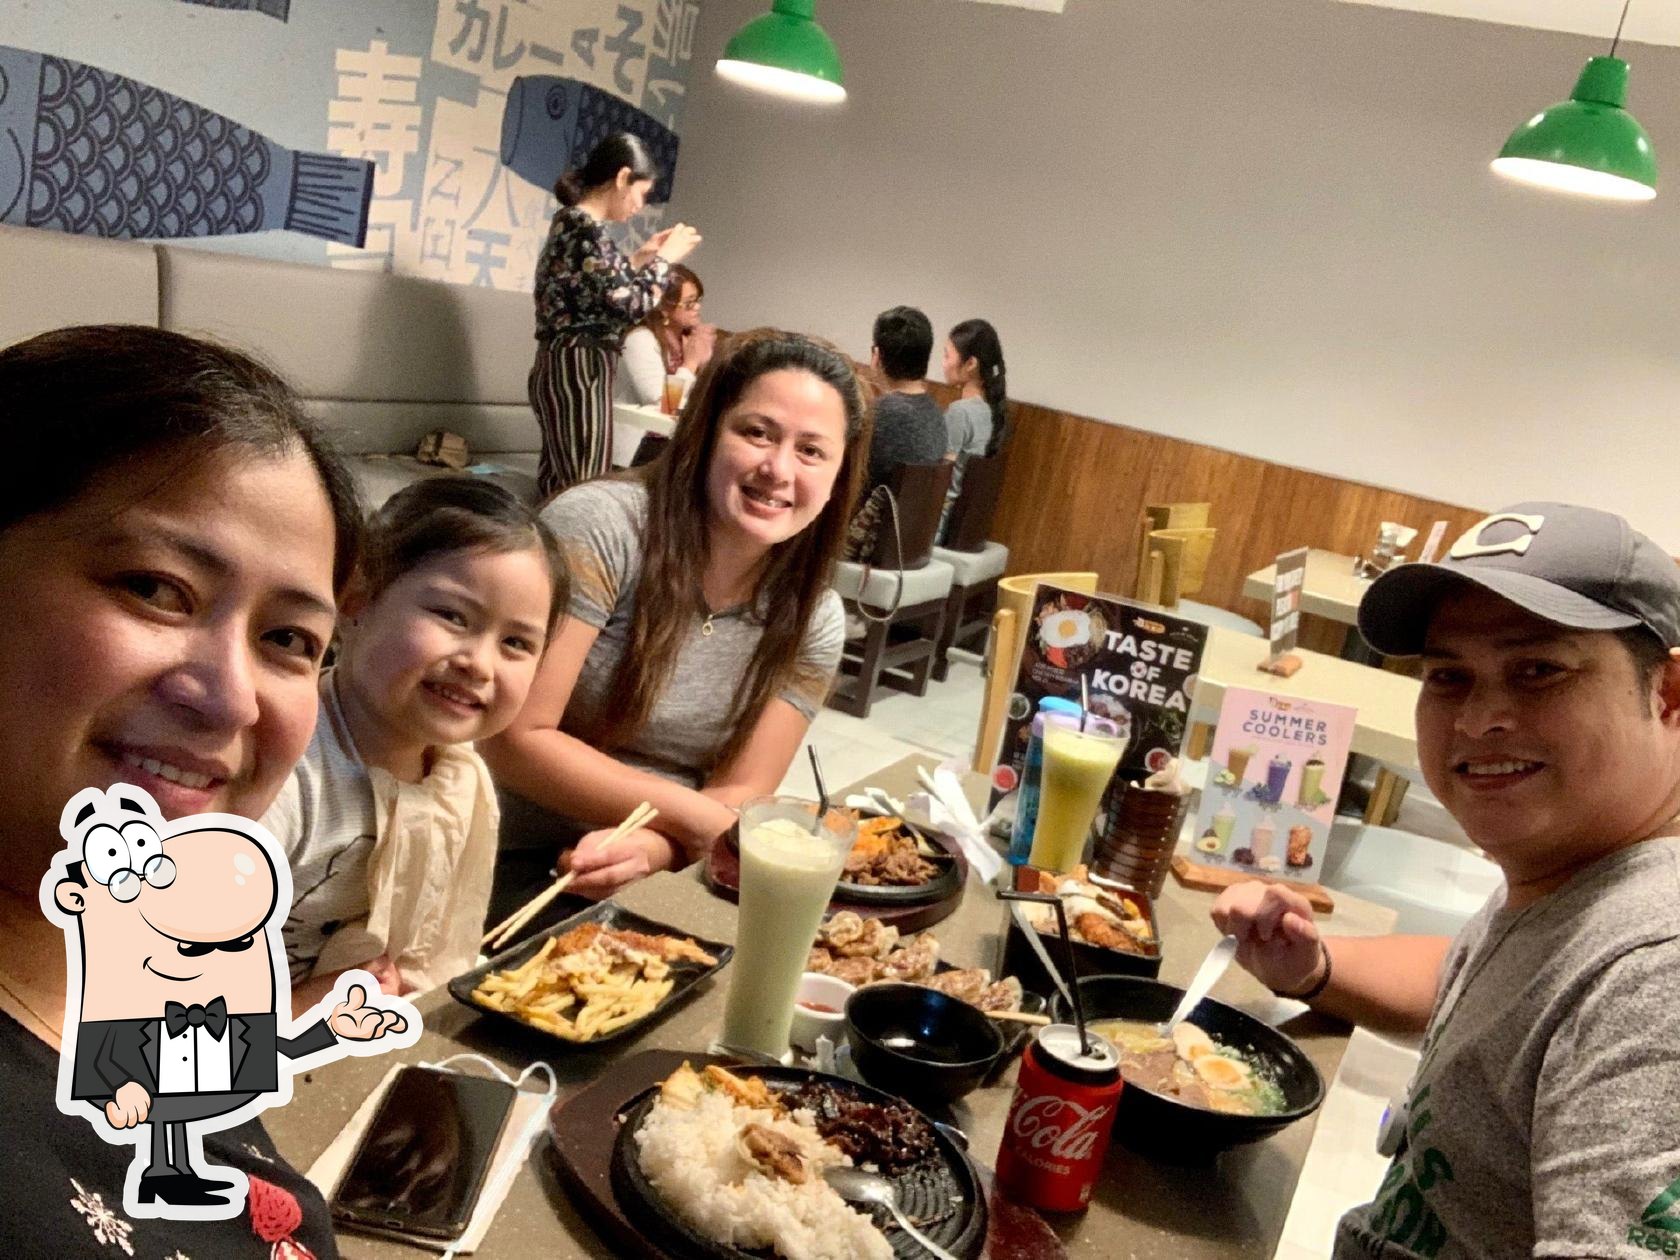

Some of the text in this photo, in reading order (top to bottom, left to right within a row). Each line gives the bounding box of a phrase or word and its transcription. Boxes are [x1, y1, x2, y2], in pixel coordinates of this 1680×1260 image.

[1450, 512, 1545, 560] C
[1105, 629, 1194, 671] TASTE
[1129, 660, 1161, 682] OF
[1091, 668, 1187, 713] KOREA
[1242, 721, 1328, 746] COOLERS
[1249, 709, 1328, 732] SUMMER
[1013, 1095, 1113, 1160] Cola
